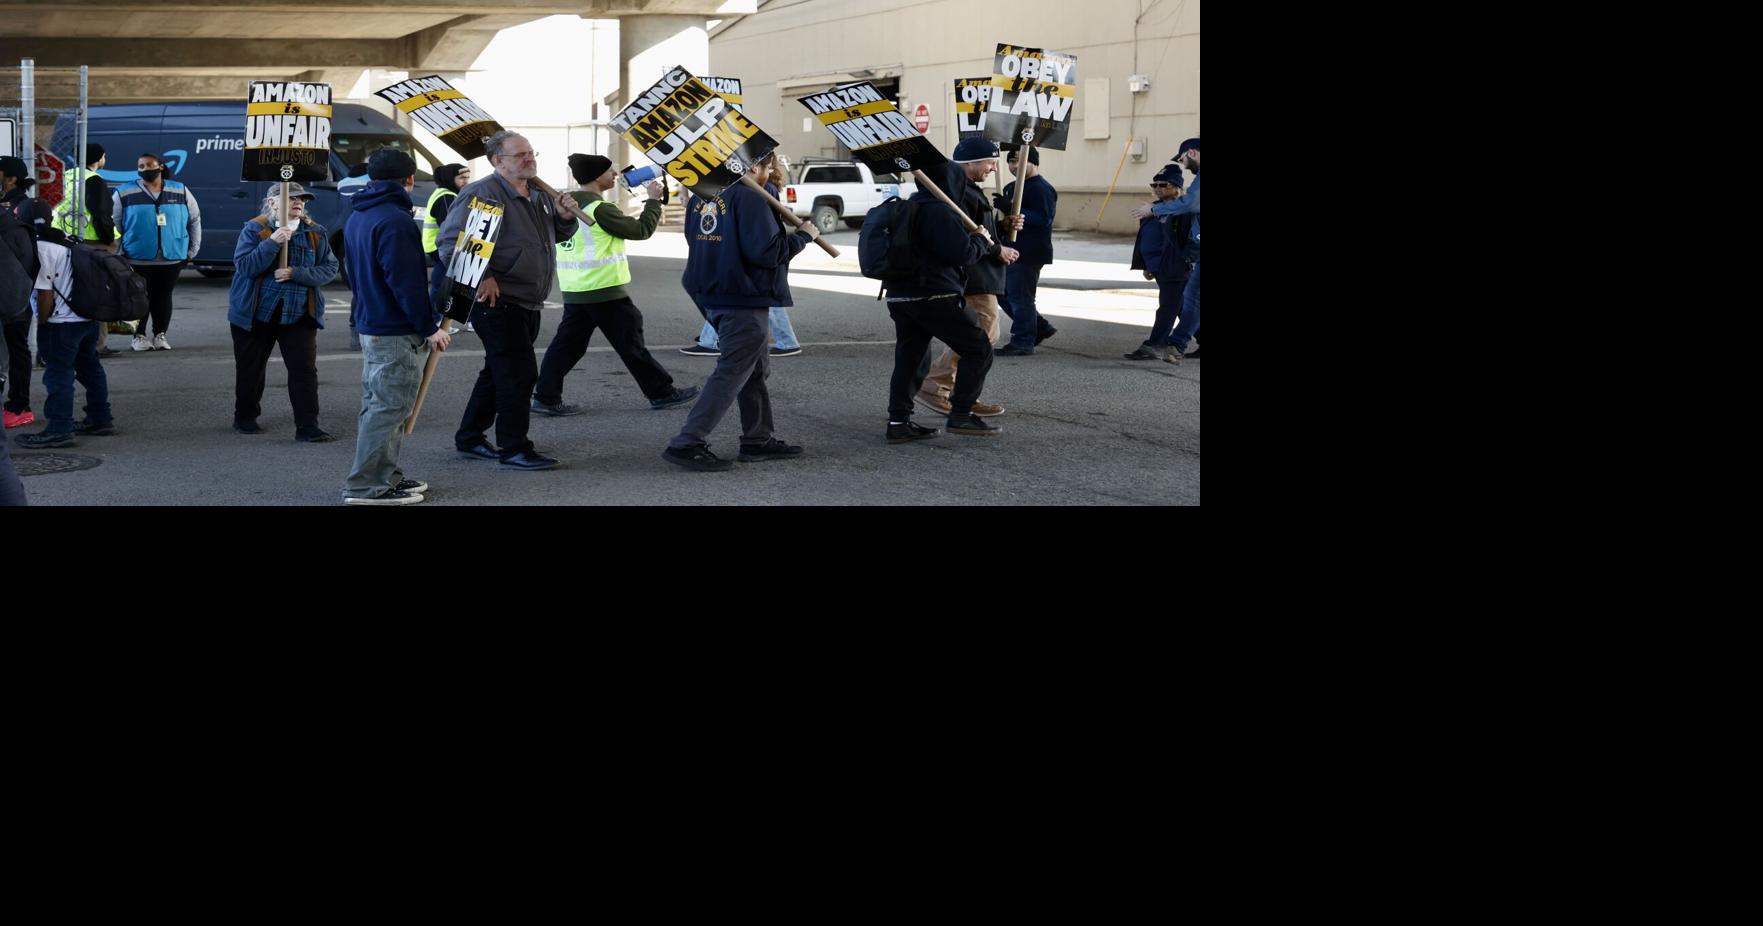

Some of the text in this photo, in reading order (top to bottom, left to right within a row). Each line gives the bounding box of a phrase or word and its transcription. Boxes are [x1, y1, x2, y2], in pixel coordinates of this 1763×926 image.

[1001, 55, 1071, 84] OBEY
[252, 83, 329, 104] AMAZON
[382, 76, 453, 104] AMAZON
[423, 93, 440, 102] is
[610, 69, 687, 130] TANNC
[701, 78, 740, 94] MAZON
[804, 84, 883, 114] AMAZON
[961, 85, 992, 103] OB
[1011, 78, 1059, 96] the
[284, 103, 300, 114] is
[407, 98, 495, 136] UNFAIR
[629, 79, 713, 150] AMAZON
[844, 108, 861, 119] is
[990, 87, 1074, 122] LAW
[196, 135, 244, 153] prime
[245, 115, 331, 149] UNFAIR
[645, 97, 725, 165] ULP
[826, 110, 921, 150] UNFAIR
[258, 149, 316, 166] INJUSTO
[667, 109, 760, 187] STRIKE
